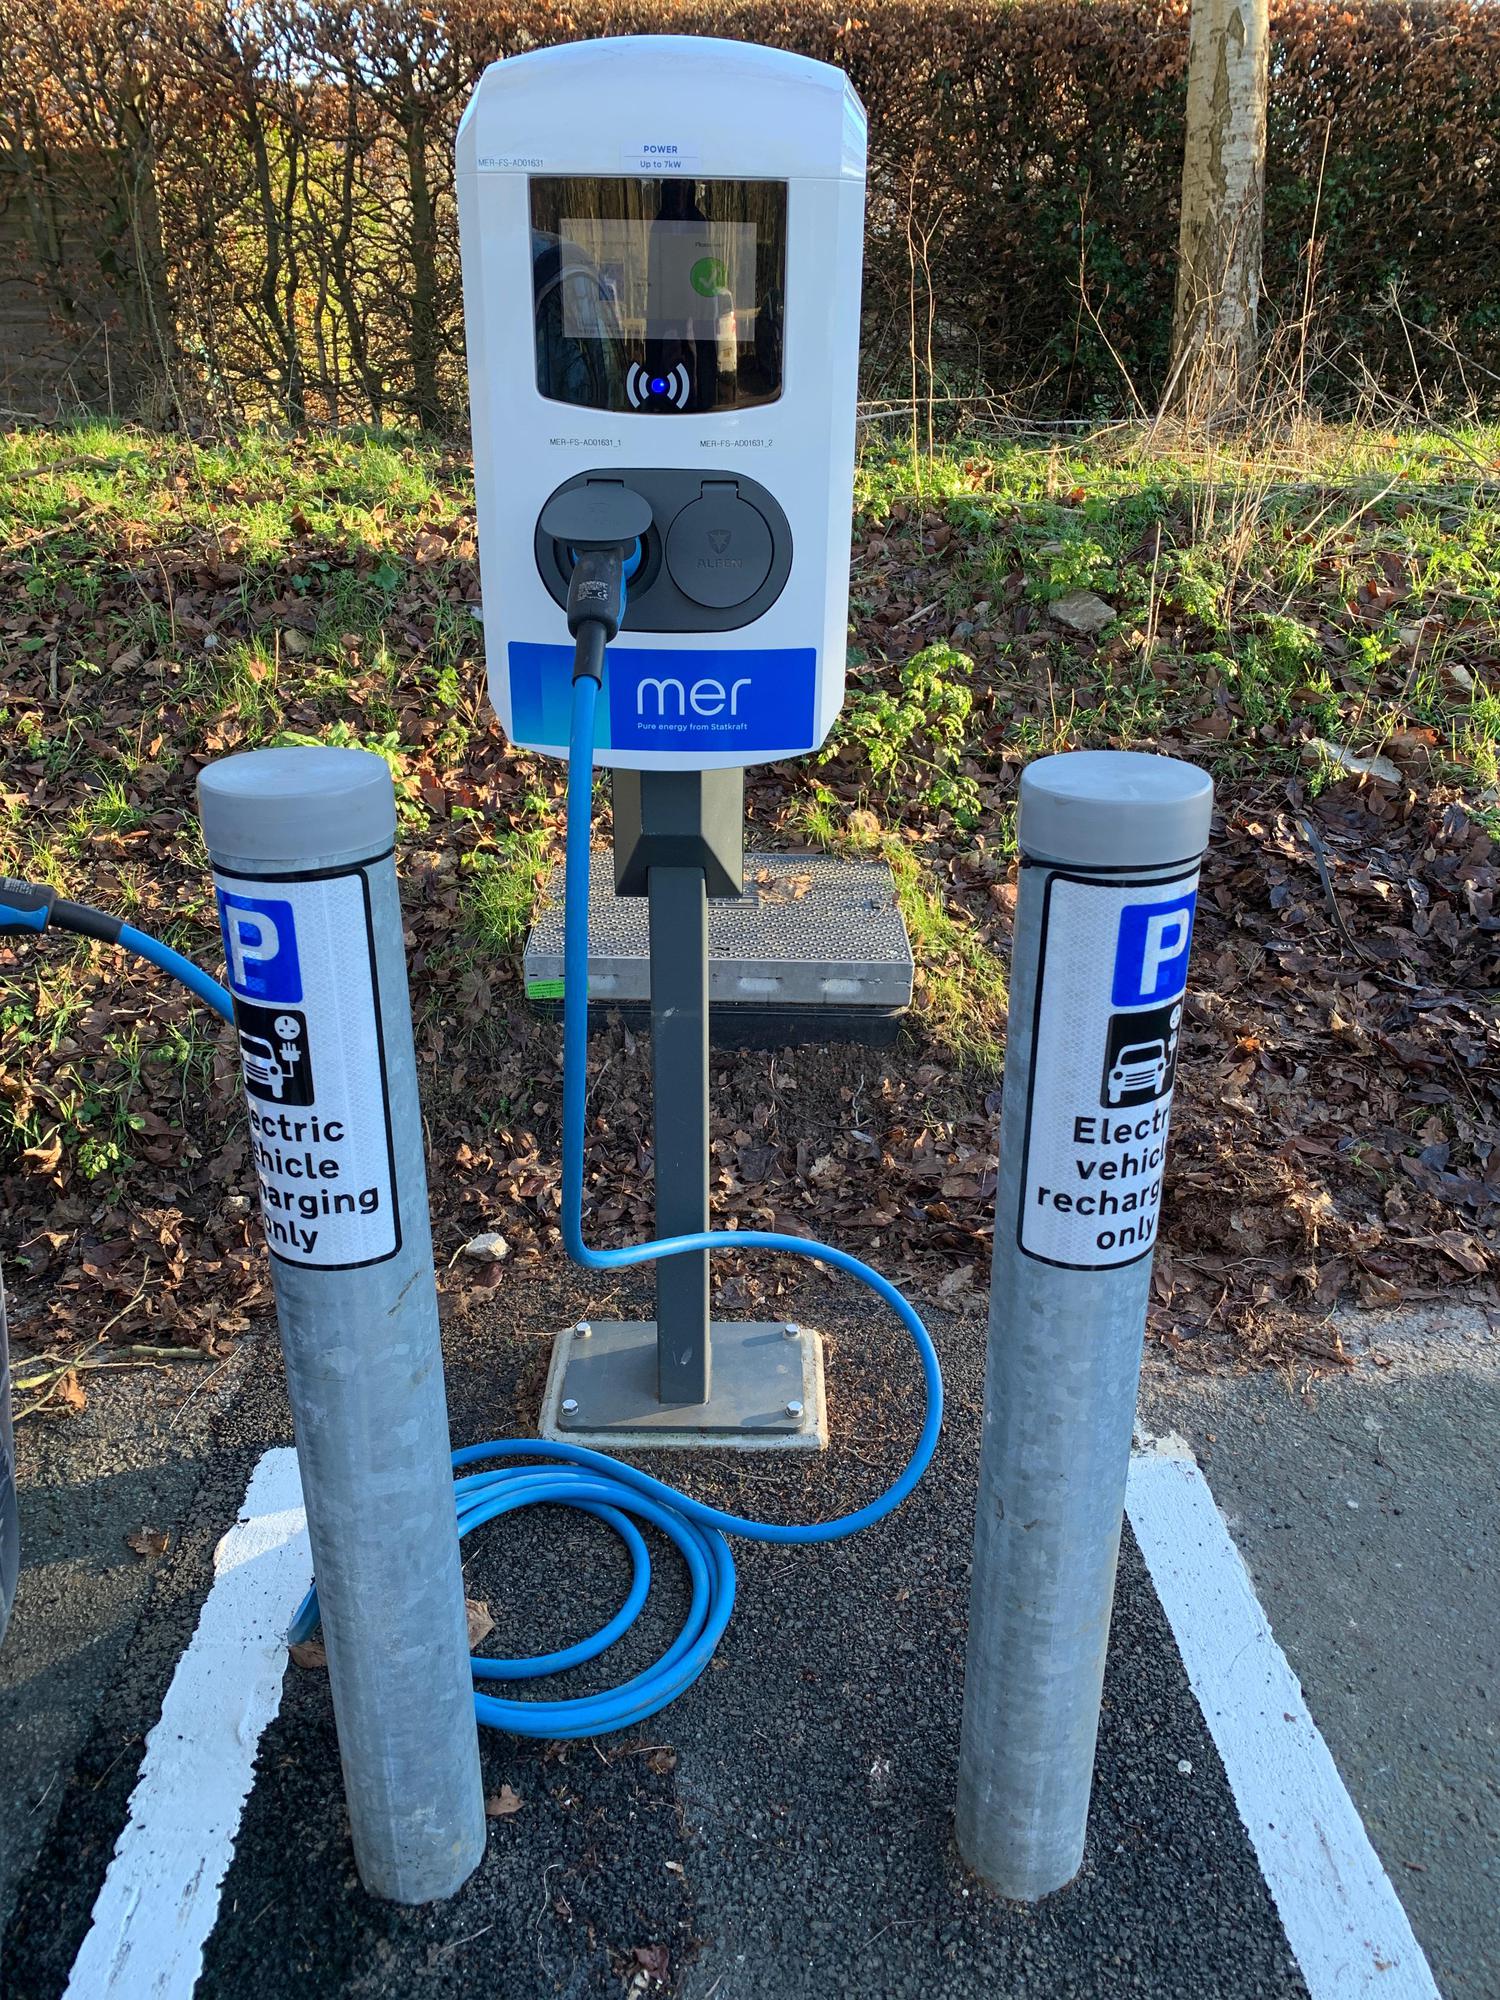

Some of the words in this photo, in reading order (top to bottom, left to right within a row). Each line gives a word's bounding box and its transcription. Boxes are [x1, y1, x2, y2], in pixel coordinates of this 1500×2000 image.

[478, 158, 544, 168] MER-FS-AD01631
[640, 160, 651, 169] Up
[653, 160, 662, 168] to
[664, 160, 681, 168] 7kW
[643, 145, 678, 154] POWER
[549, 438, 622, 448] MER-FS-AD01631_1
[699, 439, 773, 448] MER-FS-AD01631_2
[637, 678, 751, 716] mer
[637, 722, 656, 730] Pure
[658, 723, 688, 732] energy
[690, 722, 709, 731] from
[711, 722, 748, 731] Statkraft
[224, 904, 281, 987] P
[1139, 907, 1191, 996] P
[250, 1109, 345, 1143] ectric
[1073, 1107, 1168, 1145] Electr
[252, 1140, 340, 1180] ehicle
[1076, 1135, 1165, 1181] vehicl
[1038, 1177, 1160, 1216] recharg
[264, 1212, 319, 1254] only
[1096, 1212, 1156, 1250] only
